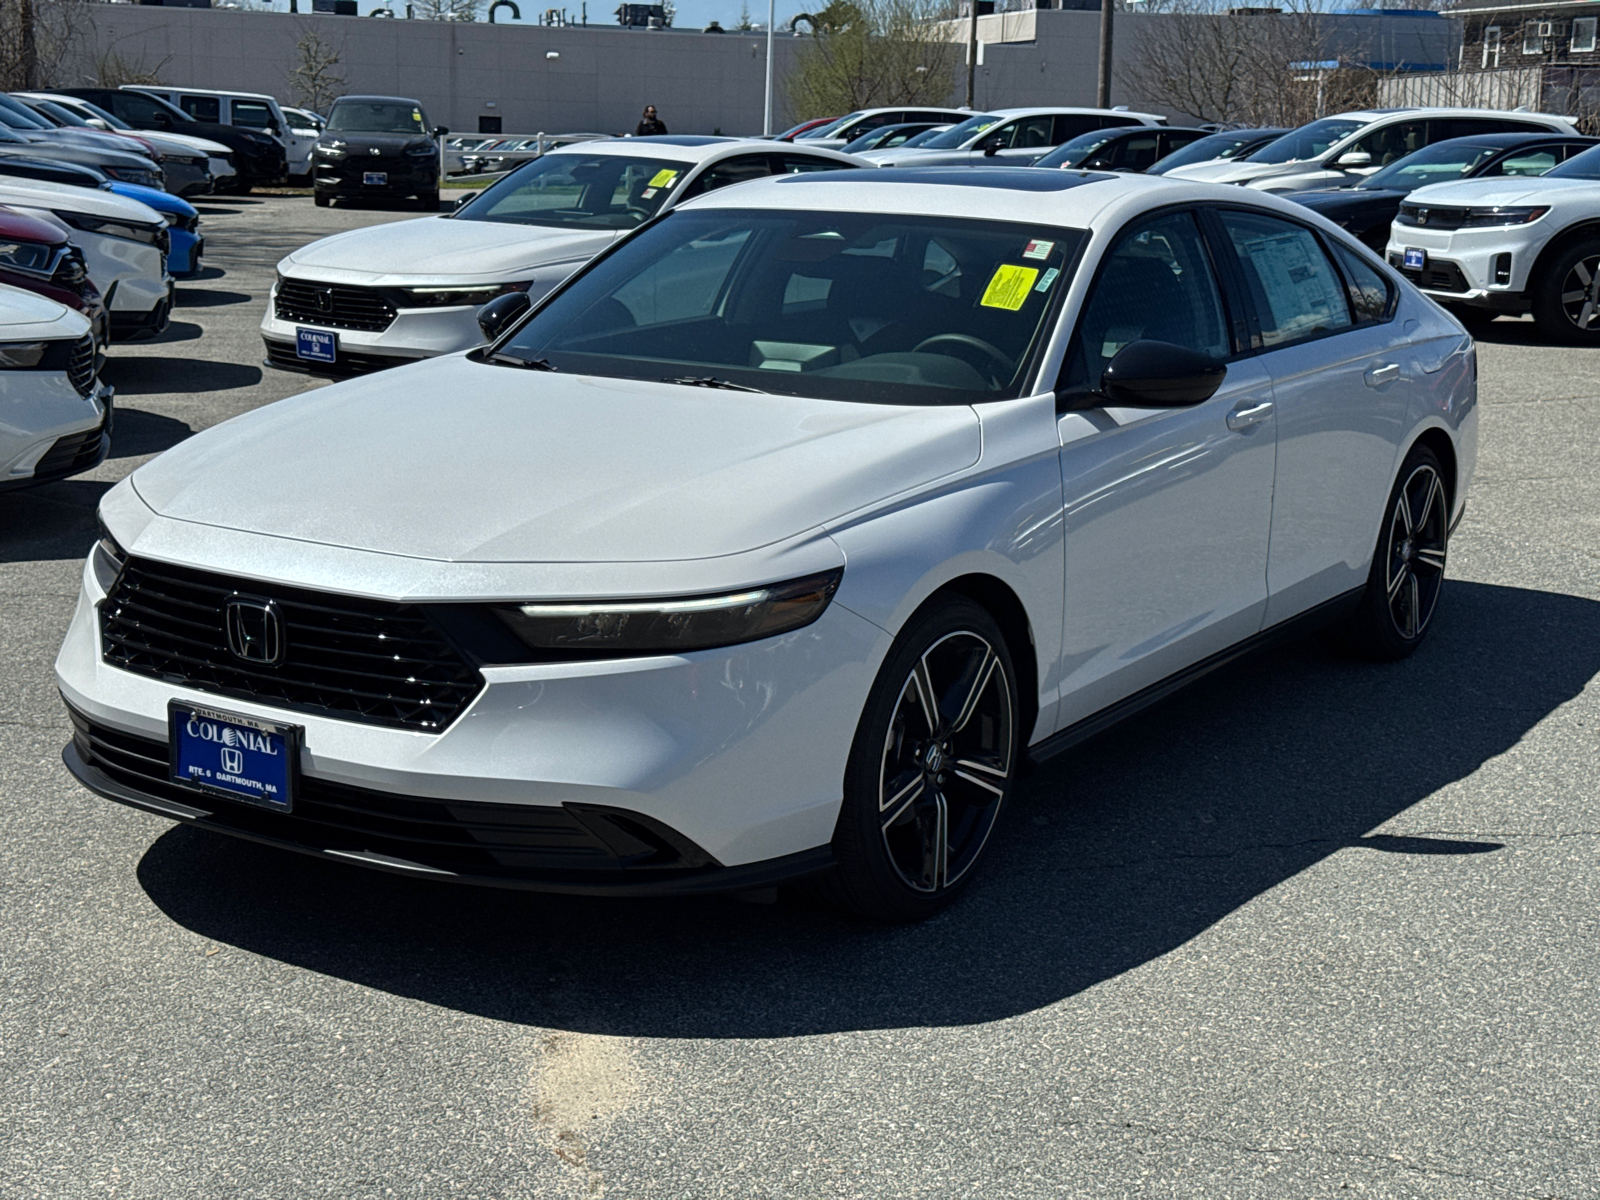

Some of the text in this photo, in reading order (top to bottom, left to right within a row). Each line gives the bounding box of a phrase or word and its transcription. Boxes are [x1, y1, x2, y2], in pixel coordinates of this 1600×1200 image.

[187, 719, 278, 755] COLONIAL
[247, 720, 260, 728] MA
[188, 765, 277, 793] RTE. 6 DARTMOUTH, MA
